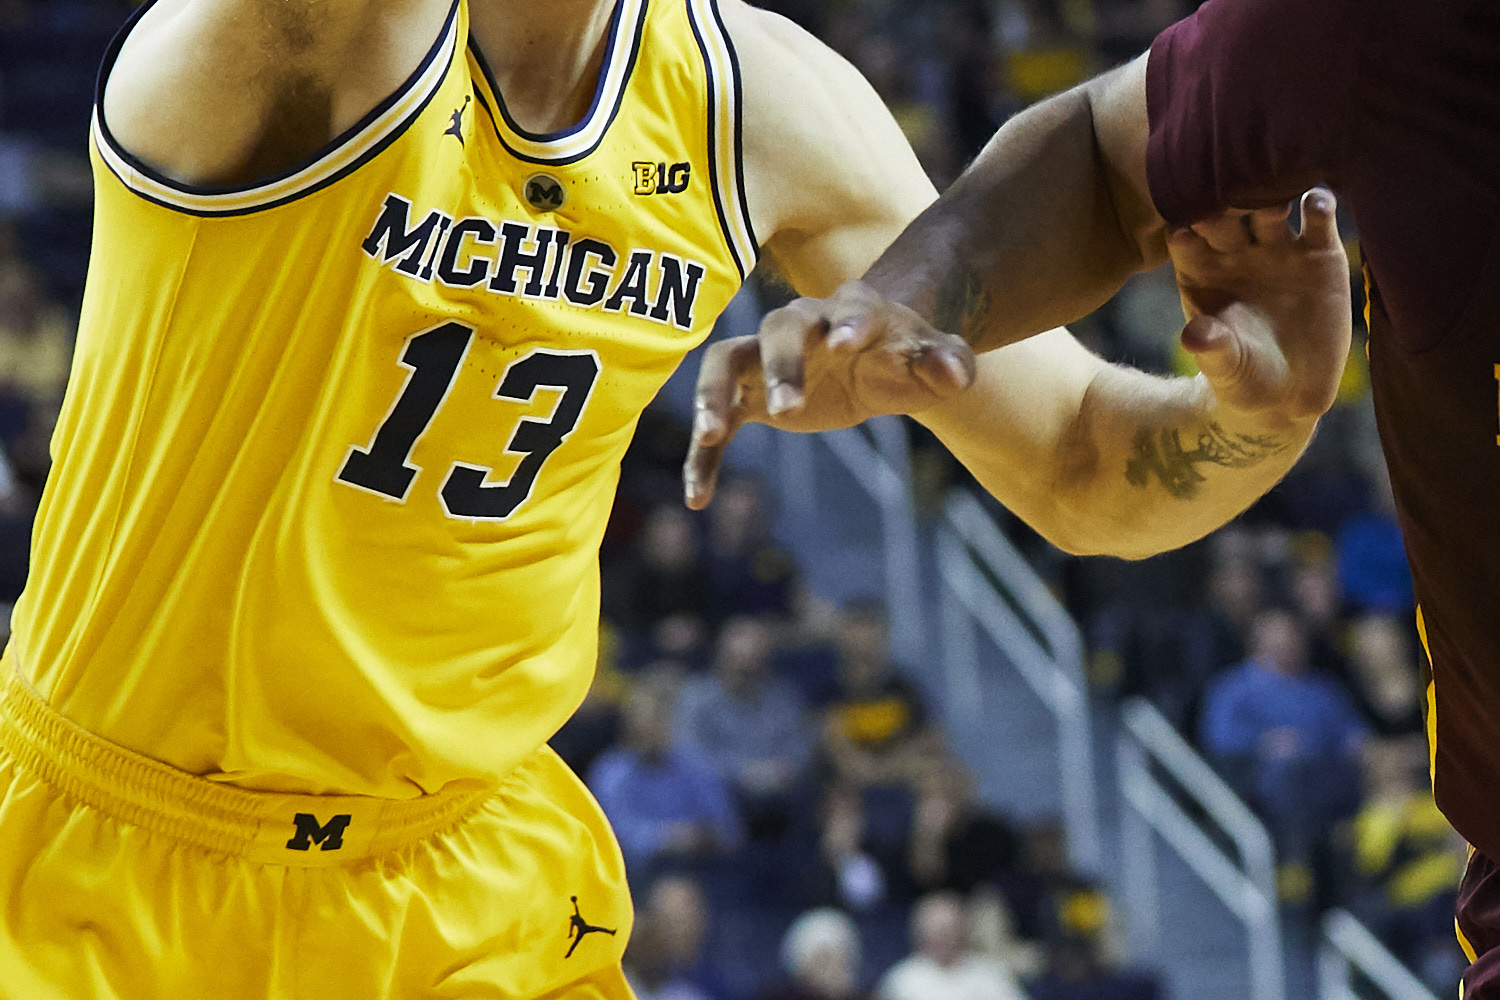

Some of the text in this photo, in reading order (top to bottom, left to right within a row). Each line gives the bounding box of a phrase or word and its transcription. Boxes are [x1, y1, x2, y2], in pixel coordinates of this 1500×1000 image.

[361, 192, 704, 332] MICHIGAN
[335, 319, 602, 522] 13
[285, 812, 352, 851] M
